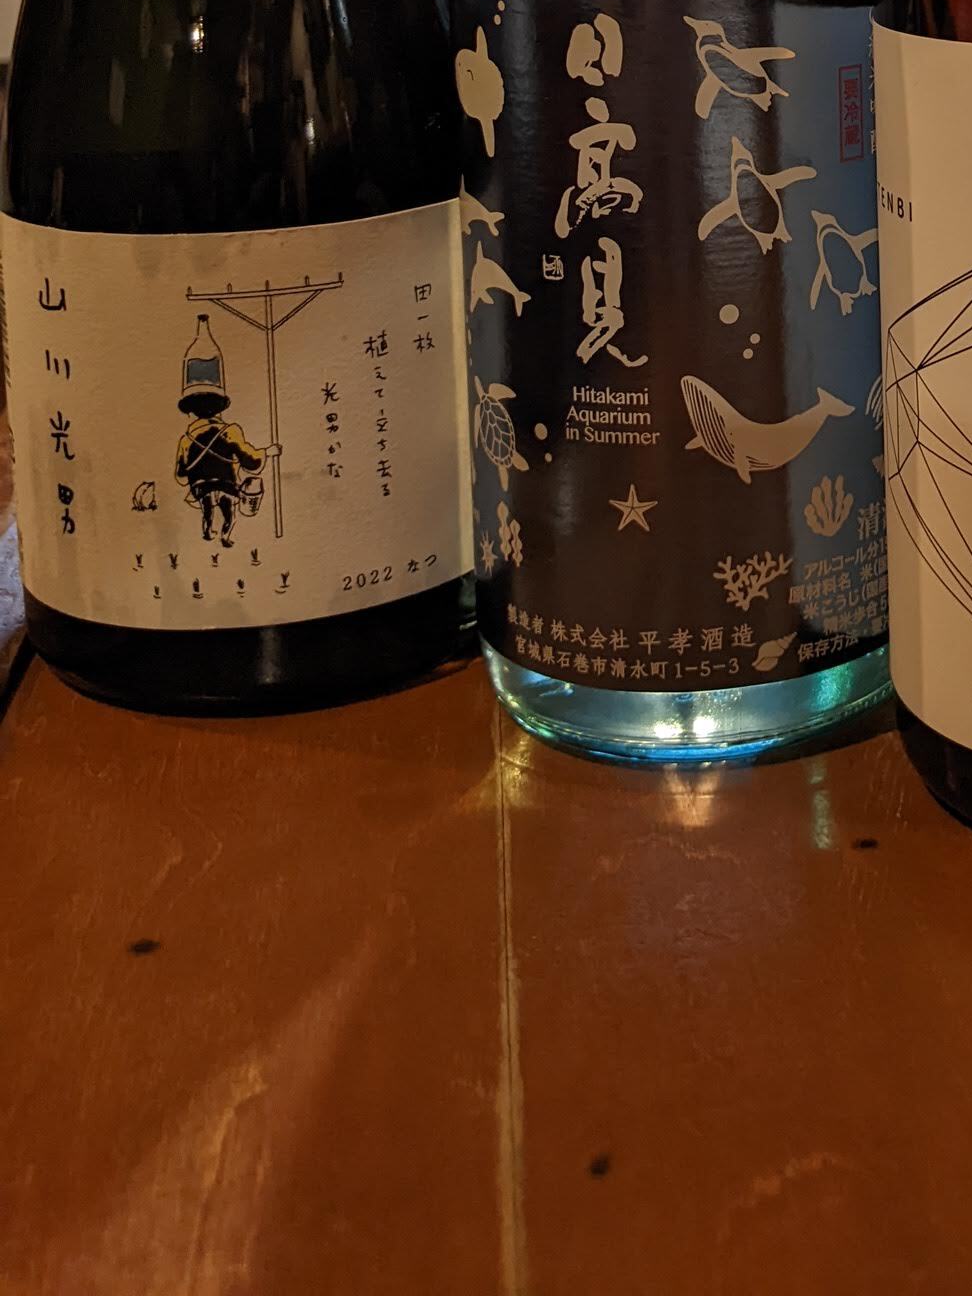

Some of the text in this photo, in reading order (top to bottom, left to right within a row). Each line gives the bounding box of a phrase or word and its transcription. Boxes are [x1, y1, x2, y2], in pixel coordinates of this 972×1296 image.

[877, 181, 913, 223] ENBI
[38, 277, 78, 535] 山川光男
[566, 405, 652, 426] Aquarium
[572, 385, 650, 407] Hitakami
[566, 425, 661, 446] in Summer
[857, 502, 887, 541] 清
[342, 553, 438, 592] 2022 なつ
[803, 536, 888, 580] アルコール分1
[797, 631, 860, 663] 保存方法
